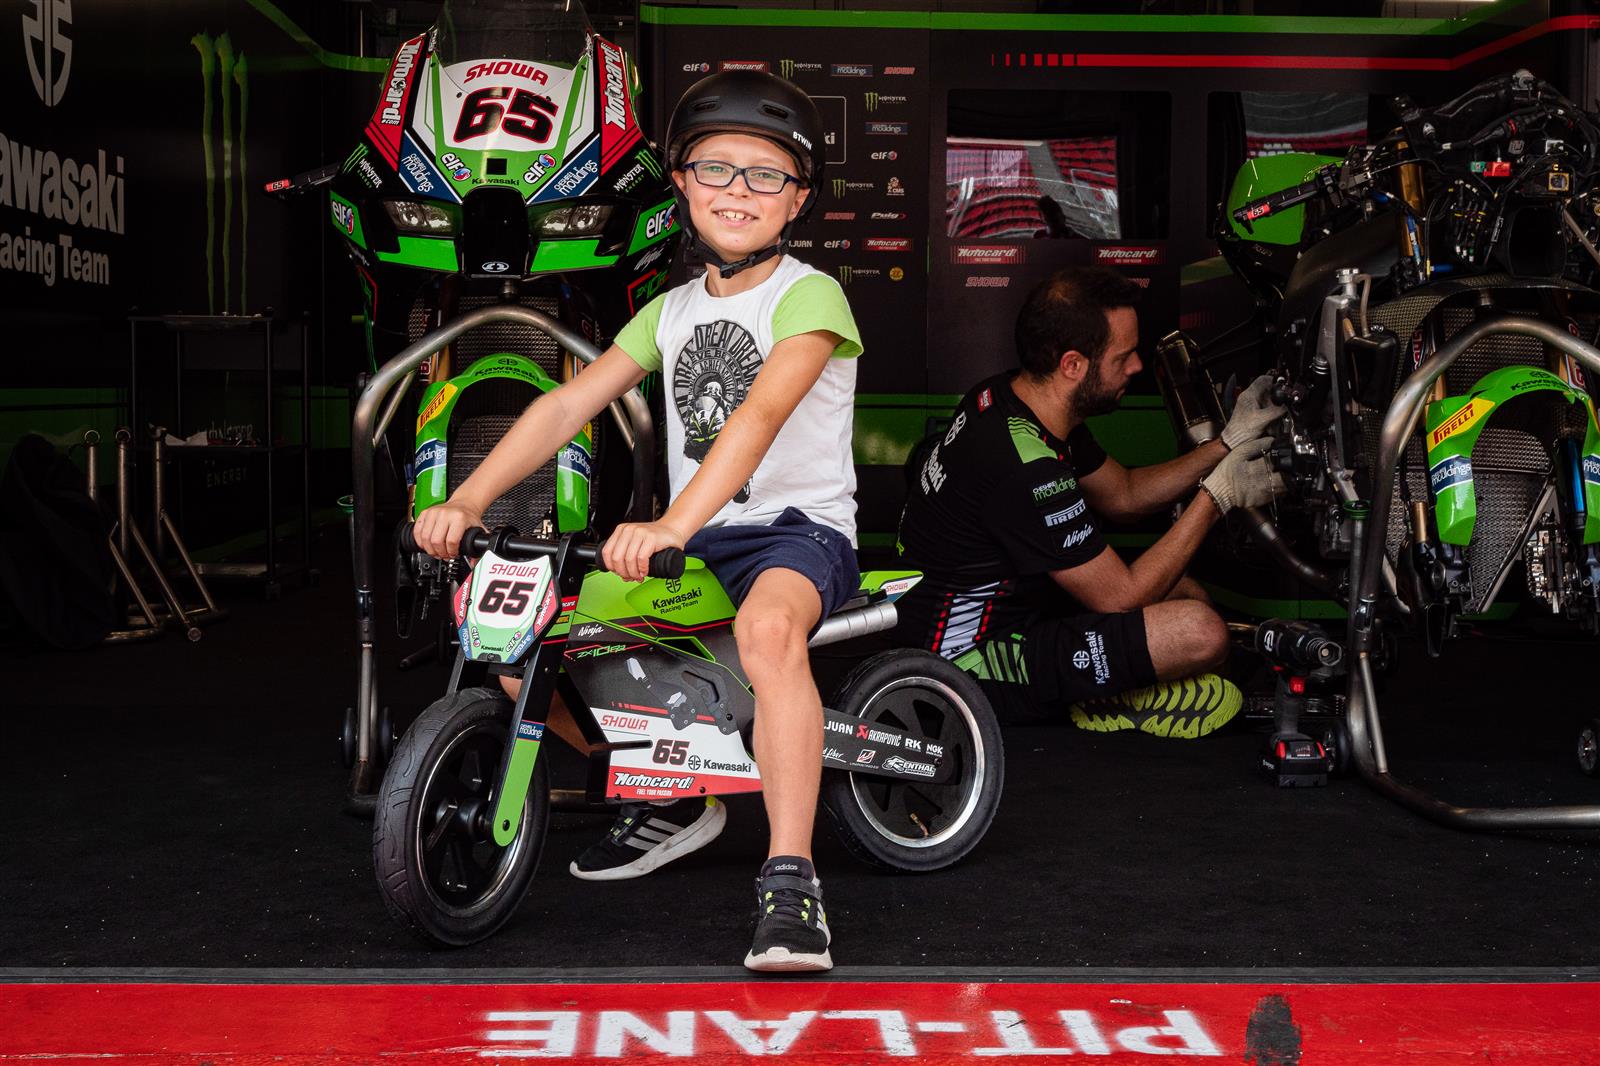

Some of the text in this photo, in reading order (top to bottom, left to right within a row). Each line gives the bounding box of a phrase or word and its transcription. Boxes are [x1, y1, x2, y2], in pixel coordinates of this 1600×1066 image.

[463, 61, 549, 87] SHOWA
[682, 62, 700, 72] elf
[453, 86, 559, 144] 65
[792, 131, 813, 151] BTWIN
[441, 152, 465, 171] elf
[871, 151, 888, 160] elf
[0, 131, 125, 235] awasaki
[360, 158, 382, 189] MONSTER
[471, 178, 520, 187] Kawasaki
[523, 161, 547, 184] elf
[558, 159, 598, 196] mouldings
[613, 163, 645, 192] MONSTER
[332, 200, 348, 225] elf
[645, 209, 666, 239] elf
[871, 212, 899, 220] Puig
[0, 225, 110, 287] acing Team
[823, 240, 841, 249] elf
[475, 366, 540, 382] Kawasaki
[420, 387, 446, 428] PIRELLI
[1434, 402, 1474, 446] PIRELLI
[1431, 463, 1472, 487] mouldings
[1044, 497, 1086, 527] PIRELLI
[1062, 523, 1093, 549] Ninja
[488, 563, 540, 579] SHOWA
[478, 579, 538, 616] 65
[651, 586, 703, 610] Kawasaki
[659, 599, 699, 615] Racing Team
[577, 623, 604, 637] Ninja
[1085, 631, 1106, 684] Kawasaki
[600, 714, 649, 731] SHOWA
[823, 720, 854, 735] .JUAN
[904, 737, 921, 750] RK
[926, 743, 944, 755] NGK
[652, 738, 690, 766] 65
[703, 759, 752, 773] Kawasaki
[775, 863, 798, 871] adidas
[477, 1010, 1223, 1058] PIT-LANE
